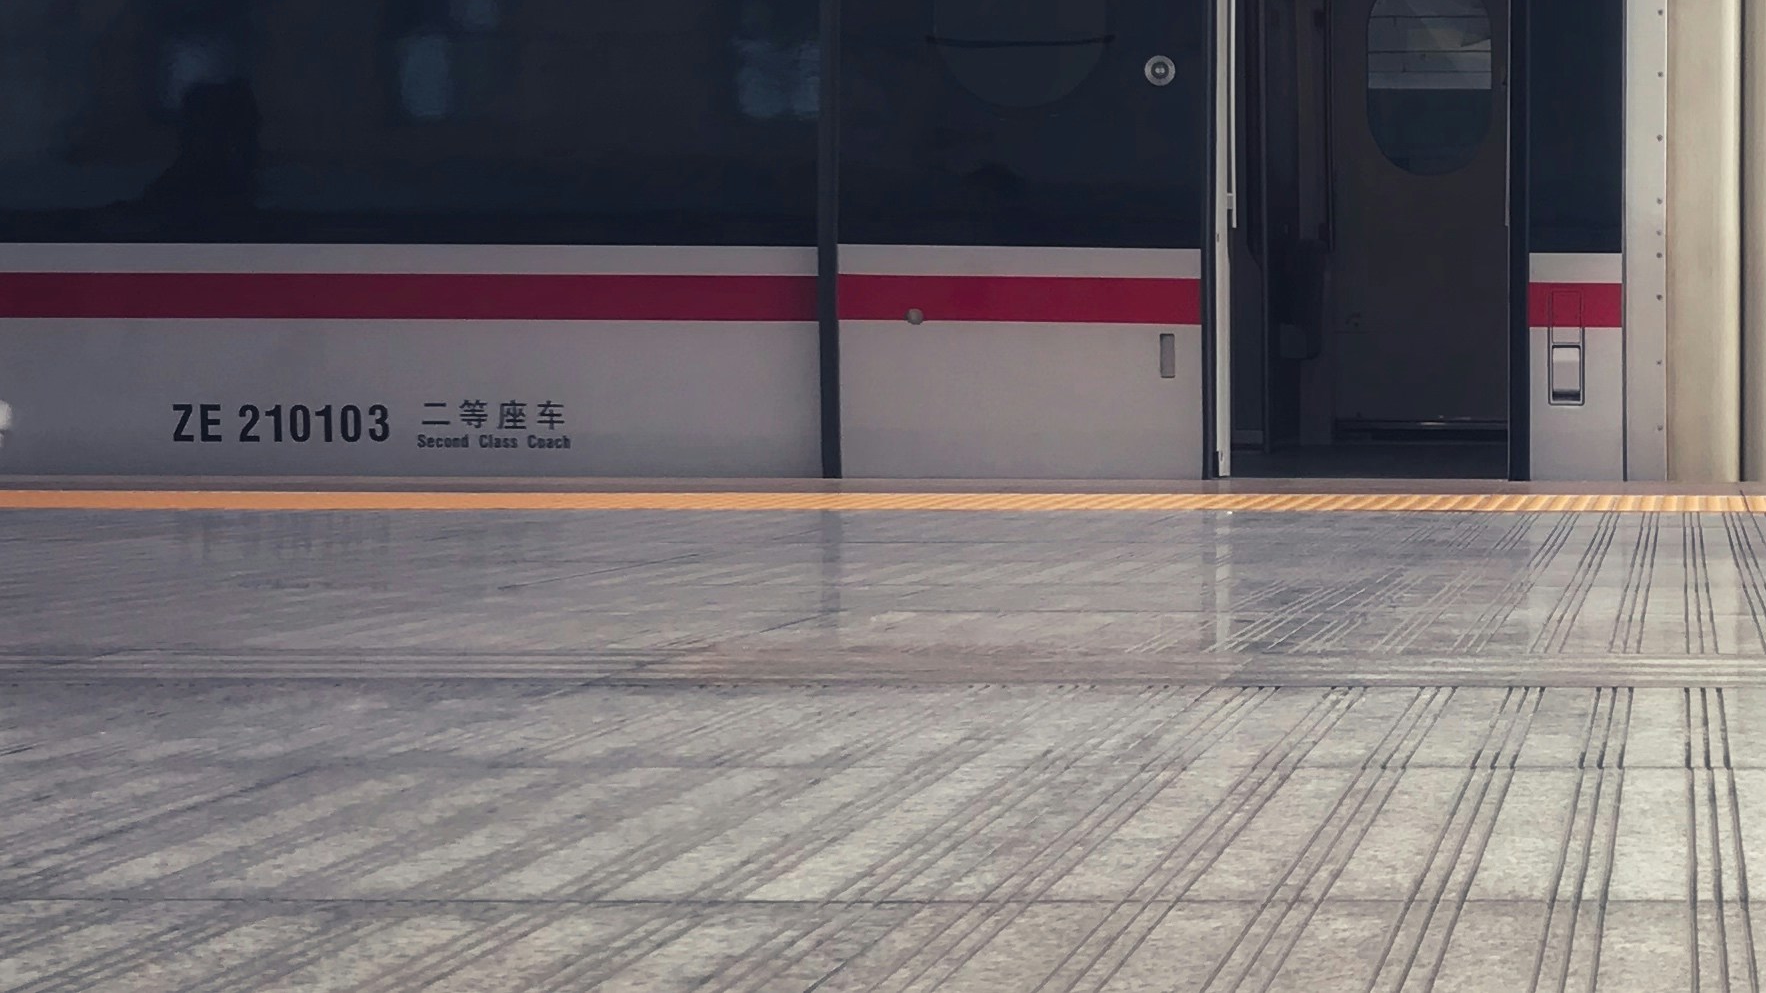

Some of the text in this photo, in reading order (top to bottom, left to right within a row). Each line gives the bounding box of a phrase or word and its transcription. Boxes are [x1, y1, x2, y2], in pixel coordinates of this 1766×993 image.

[172, 404, 390, 443] ZE 210103
[422, 399, 565, 430] 二等座车
[417, 433, 571, 450] Second Class Coach
